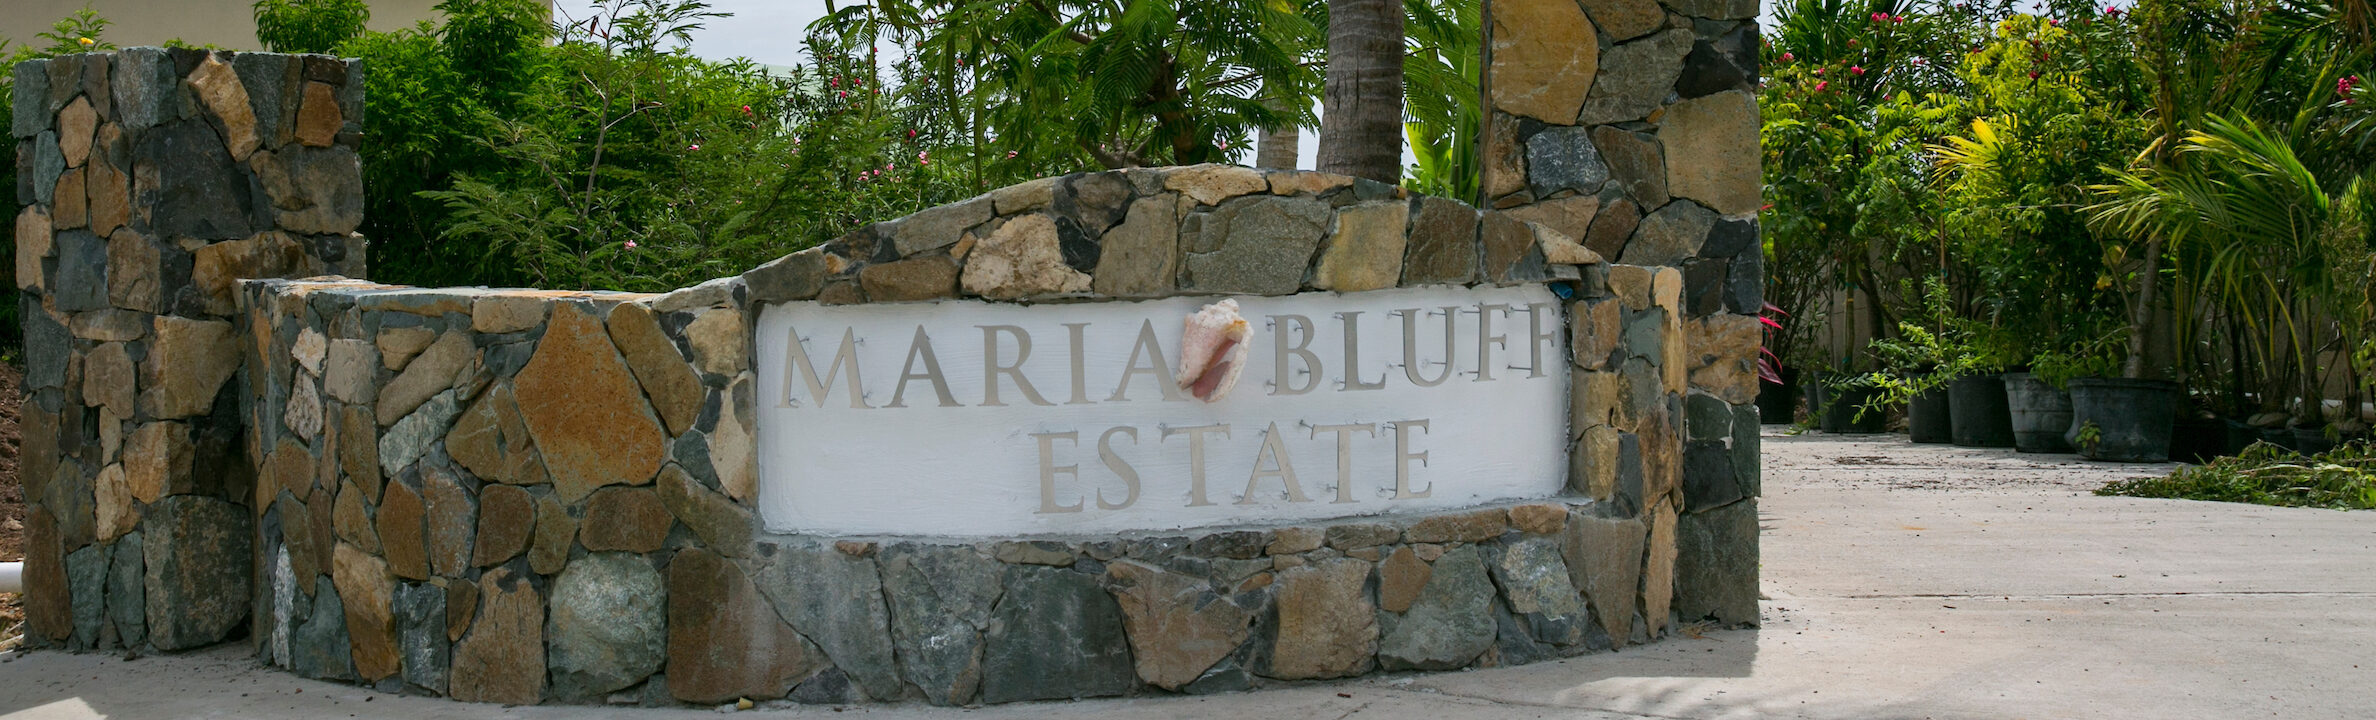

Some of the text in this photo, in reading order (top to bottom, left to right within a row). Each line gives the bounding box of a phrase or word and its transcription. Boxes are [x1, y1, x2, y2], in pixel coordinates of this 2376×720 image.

[775, 302, 1556, 409] MARIA BLUFF
[1028, 418, 1433, 514] ESTATE
